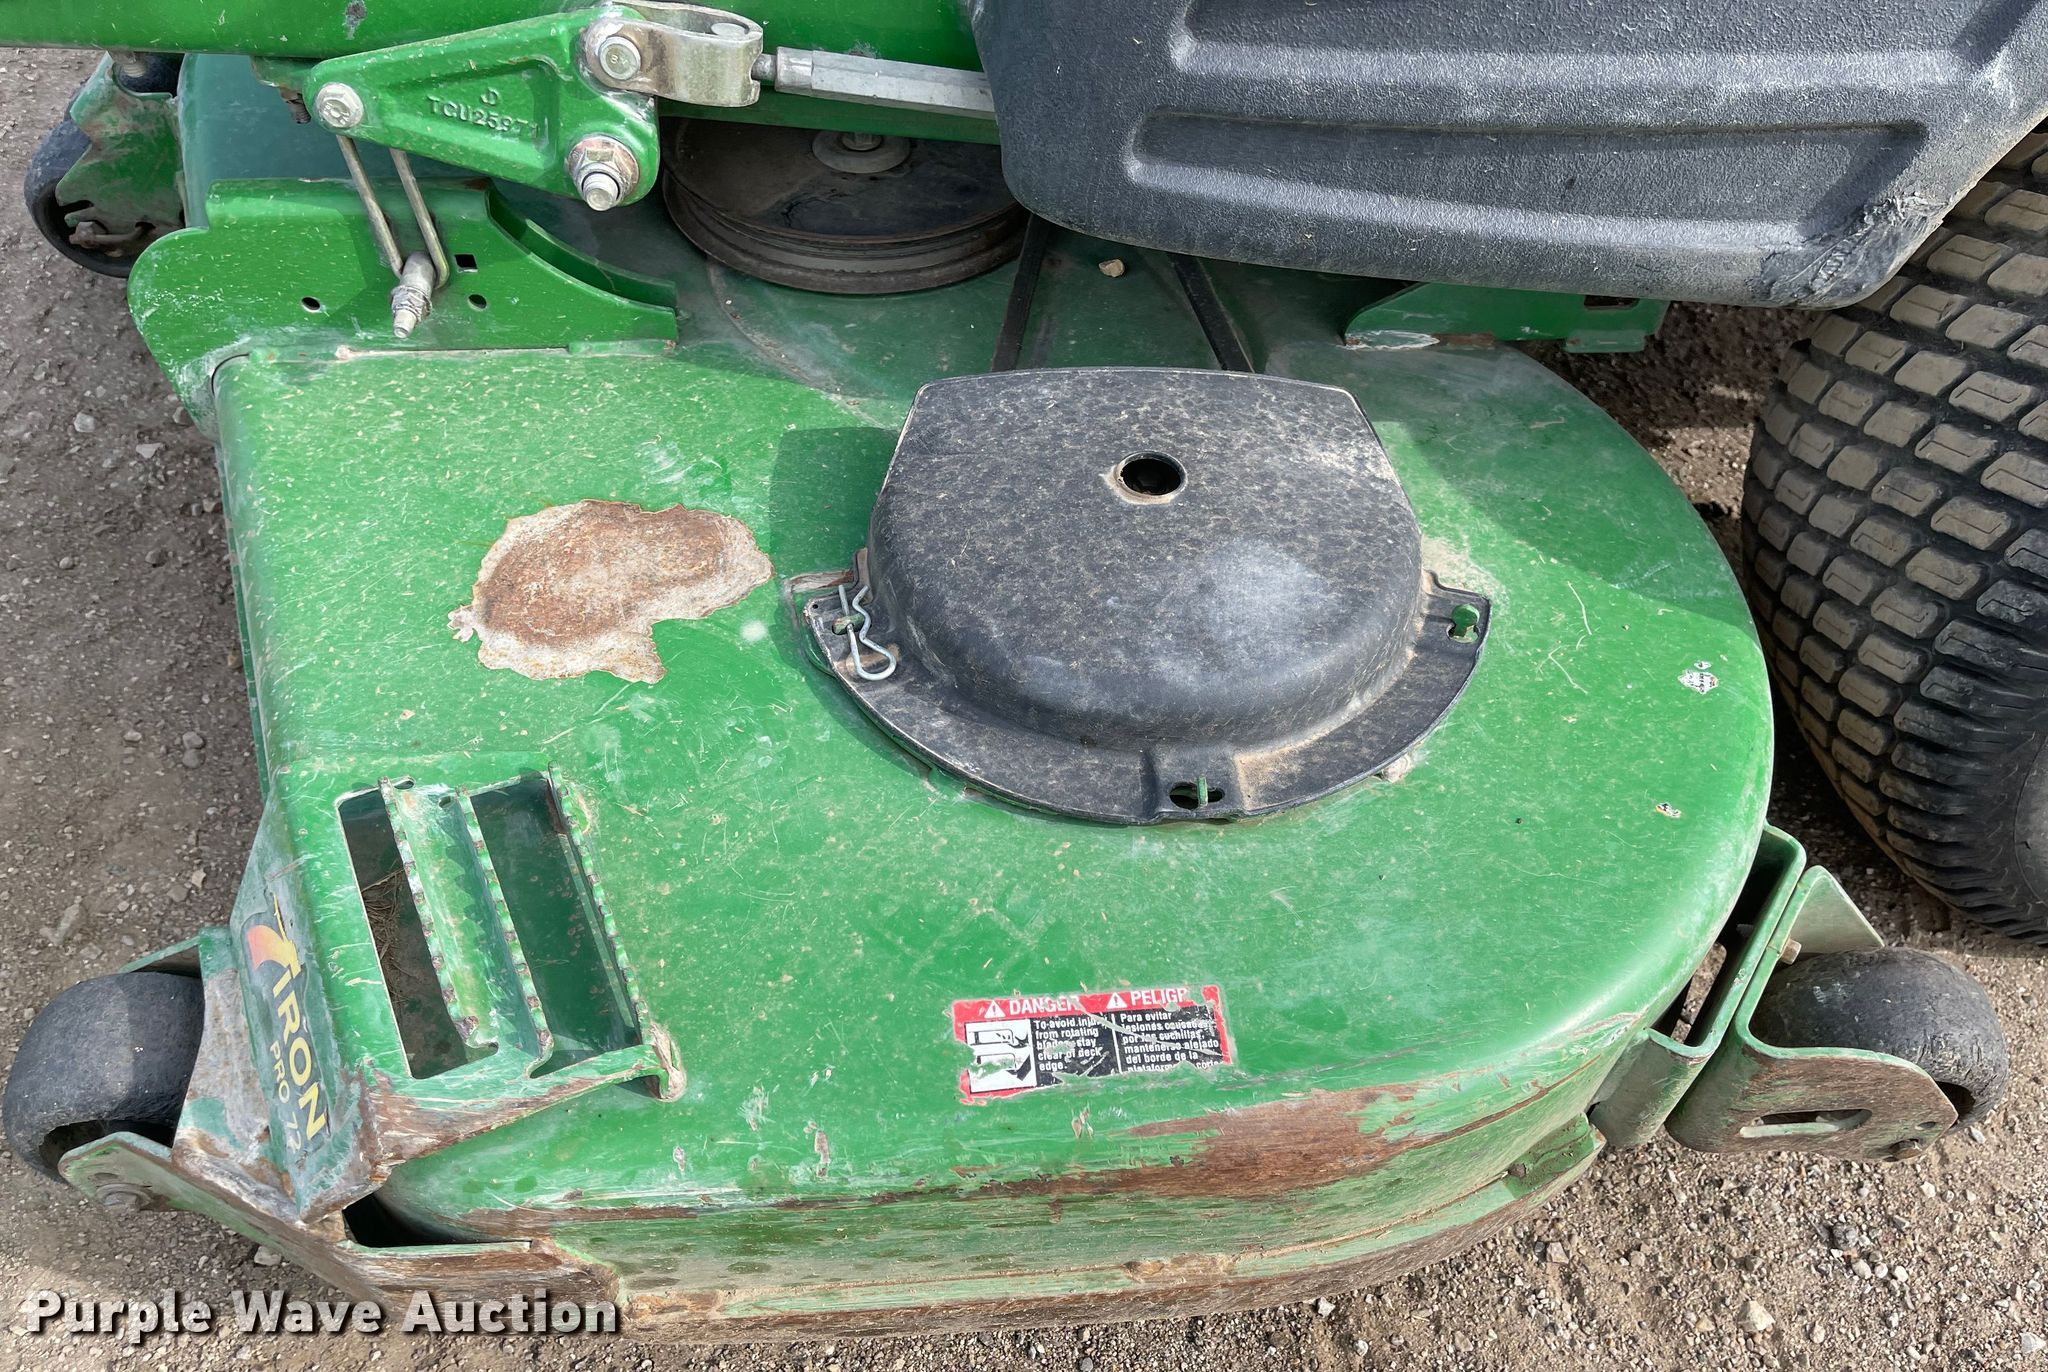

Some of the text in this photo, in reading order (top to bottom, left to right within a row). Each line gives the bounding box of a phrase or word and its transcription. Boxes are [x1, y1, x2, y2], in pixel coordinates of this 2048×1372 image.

[1130, 987, 1188, 1006] PELIGR
[1033, 1014, 1107, 1030] To avoid inju
[1120, 1011, 1172, 1023] Para evitar
[1035, 1027, 1099, 1040] from rotating
[1076, 1037, 1097, 1048] stay
[1122, 1034, 1139, 1046] por
[1078, 1046, 1103, 1057] deck
[1124, 1039, 1219, 1054] mantenerse alejado
[1125, 1050, 1199, 1064] del borde de la
[270, 1040, 290, 1104] PRO
[1039, 1061, 1068, 1072] edge.
[1127, 1062, 1176, 1072] plataform
